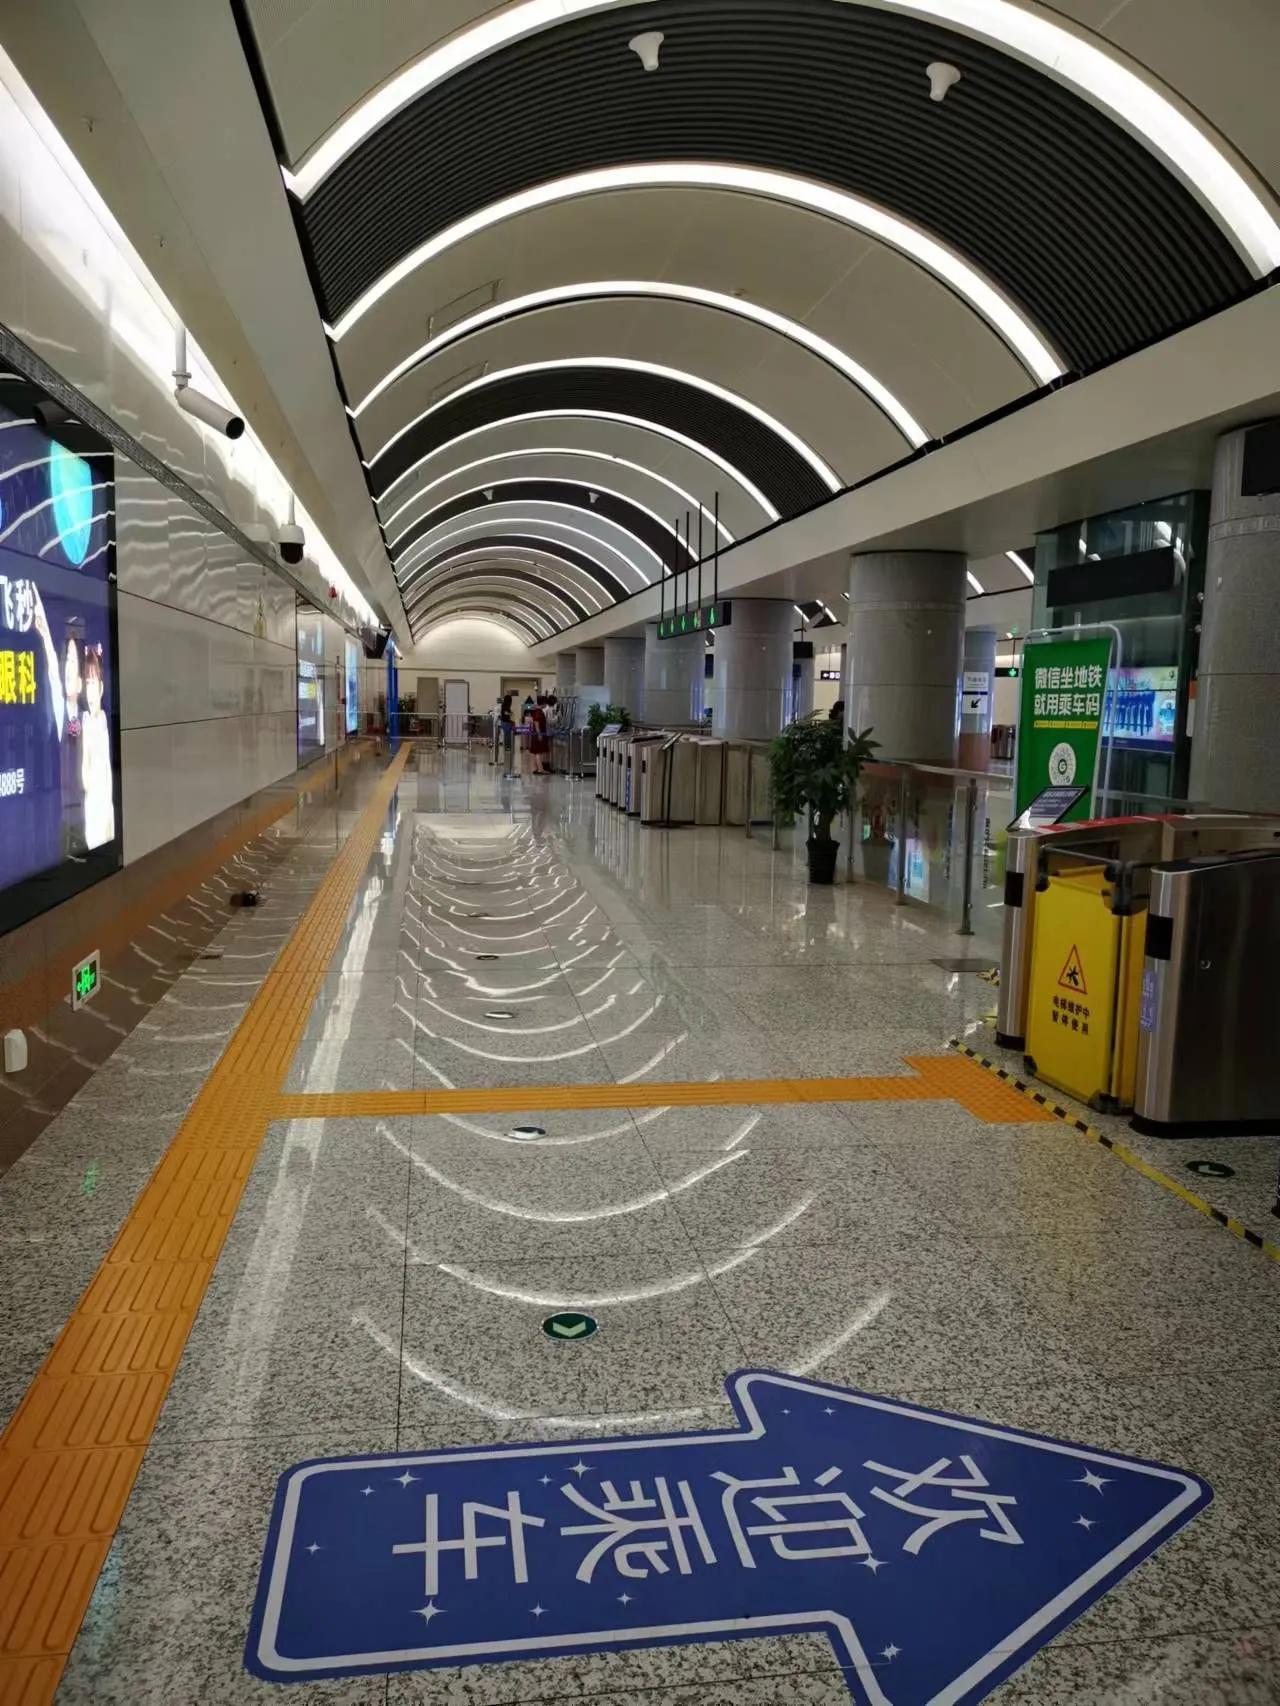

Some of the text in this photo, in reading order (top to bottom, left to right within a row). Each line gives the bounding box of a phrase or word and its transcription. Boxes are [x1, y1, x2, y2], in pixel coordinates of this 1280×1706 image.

[1034, 665, 1102, 689] 微信坐地铁
[1034, 692, 1100, 716] 就用乘车码
[391, 1453, 1025, 1598] 欢迎乘车
